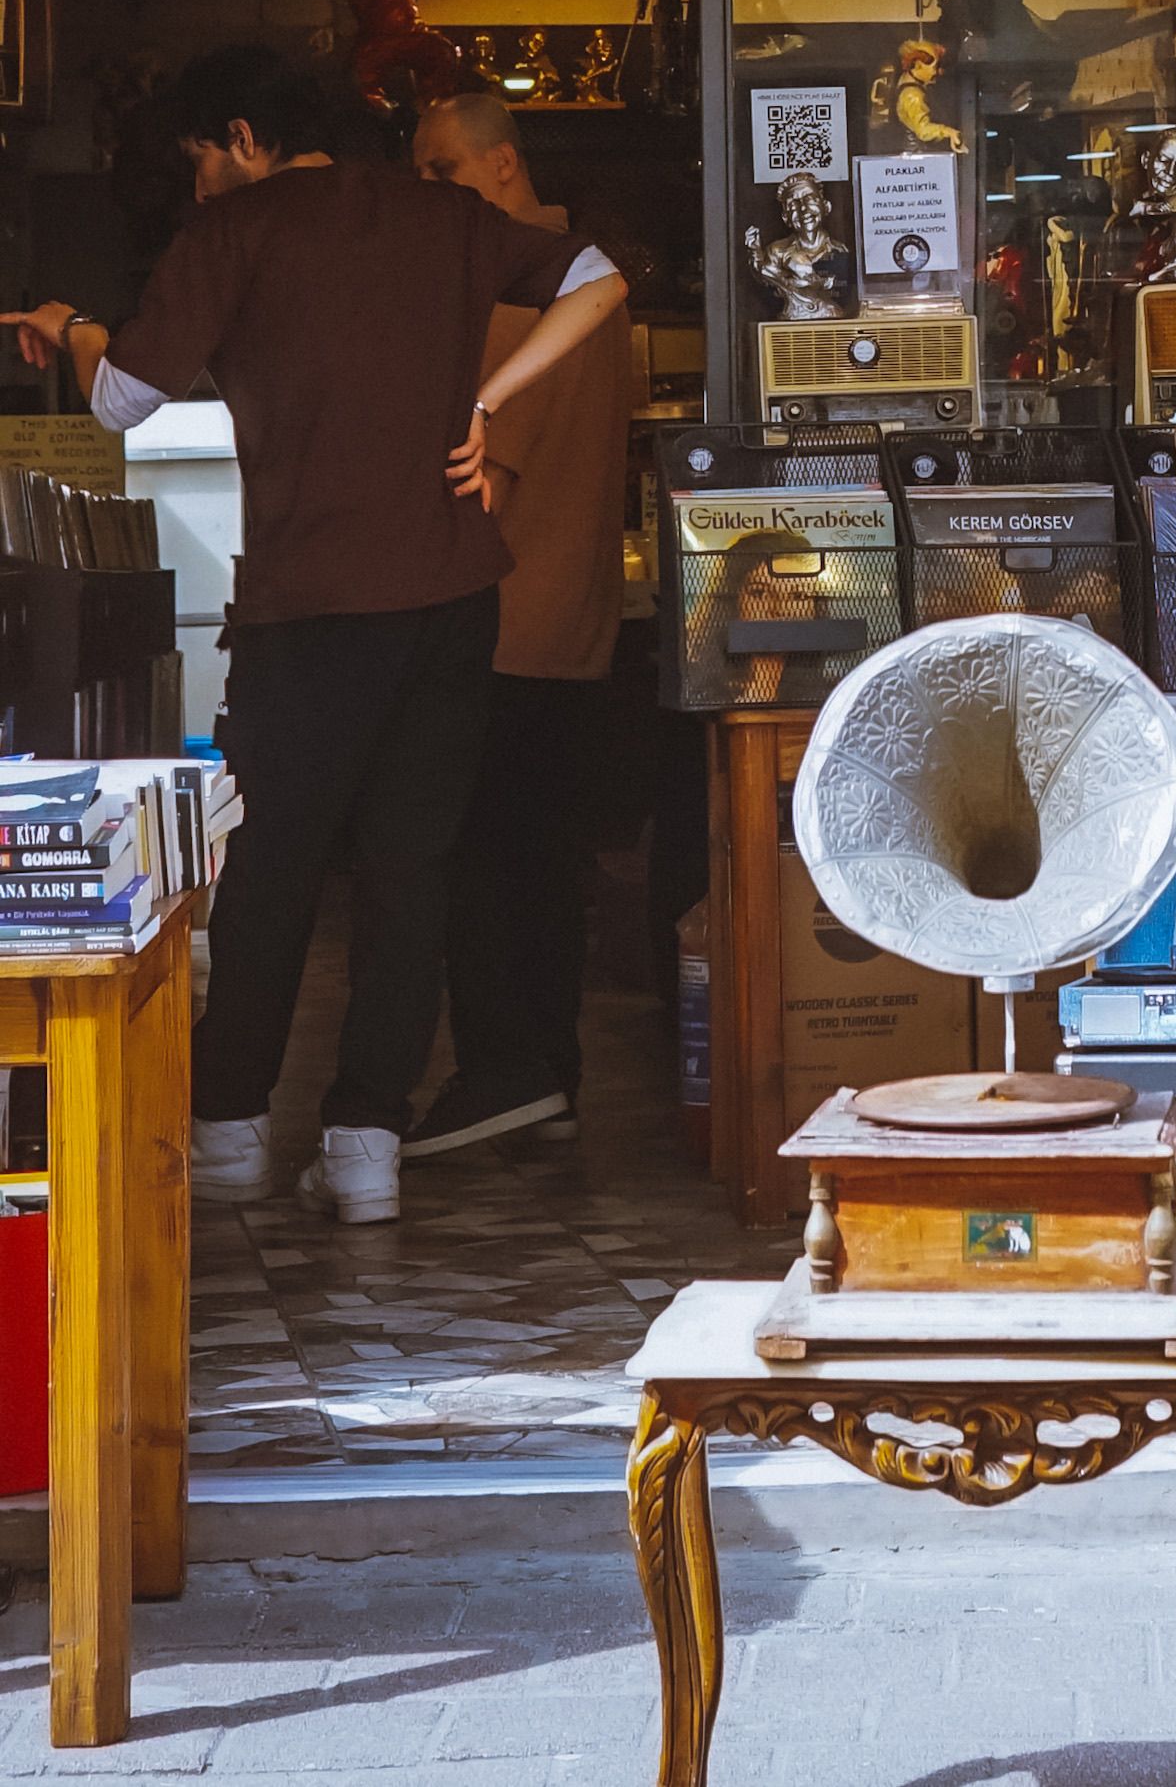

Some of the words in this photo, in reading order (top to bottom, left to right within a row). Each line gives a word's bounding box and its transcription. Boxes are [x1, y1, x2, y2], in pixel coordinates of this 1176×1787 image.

[885, 166, 925, 176] PLAKLAR
[49, 433, 95, 444] EDITION
[688, 507, 765, 531] Gülden
[771, 507, 887, 534] Karaböcek
[950, 516, 1003, 531] KEREM
[1009, 513, 1074, 530] GÖRSEV
[999, 535, 1012, 543] THE
[16, 823, 50, 845] KİTAP
[21, 850, 92, 867] GOMORRA
[31, 882, 75, 901] KARŞI
[785, 998, 834, 1012] WOODEN
[835, 995, 879, 1009] CLASSIC
[882, 993, 919, 1006] SERIES
[807, 1017, 839, 1030] RETRO
[842, 1014, 898, 1028] TURNTABLE
